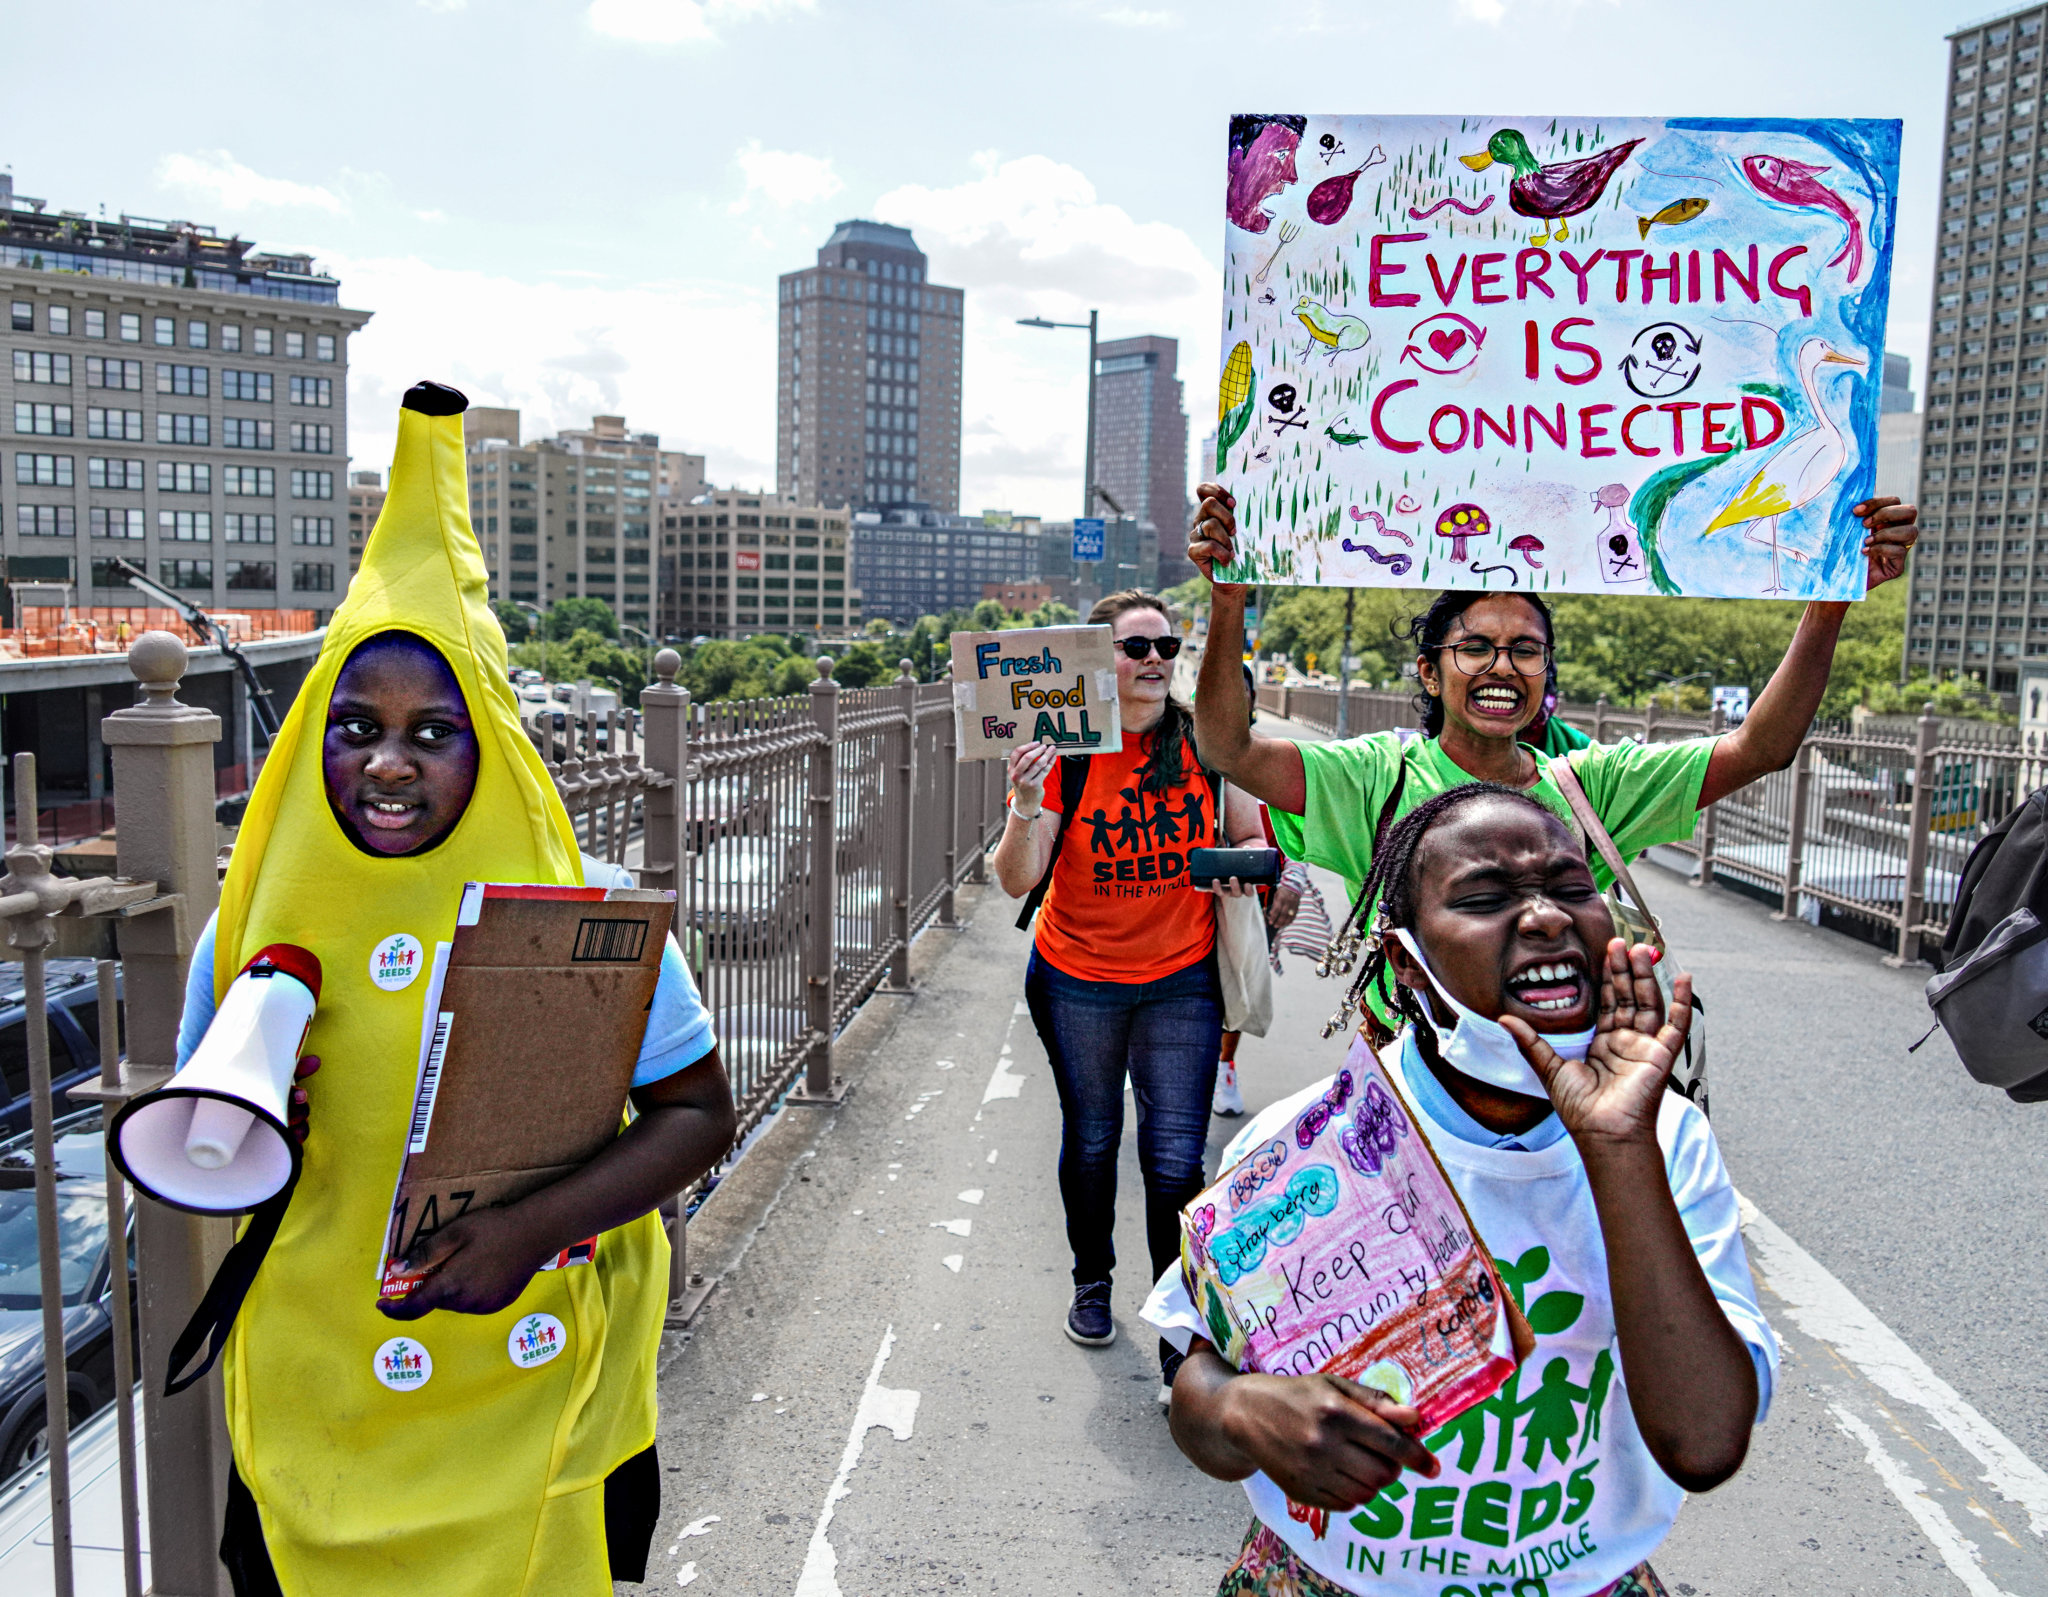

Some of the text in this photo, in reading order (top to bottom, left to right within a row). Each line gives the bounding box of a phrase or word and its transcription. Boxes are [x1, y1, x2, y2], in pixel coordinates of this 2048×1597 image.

[1369, 232, 1812, 317] EVERYTHING
[1525, 317, 1603, 385] IS
[1370, 378, 1786, 458] CONNECTED
[976, 642, 1062, 680] Fresh
[1011, 675, 1086, 710] Food
[982, 710, 1102, 743] For ALL
[1094, 876, 1189, 898] IN THE MIL
[378, 967, 412, 978] SEEDS
[383, 1279, 409, 1293] mile
[1281, 1241, 1370, 1316] Keep
[1273, 1266, 1428, 1376] mmunity
[522, 1342, 557, 1362] SEEDS
[386, 1370, 423, 1380] SEEDS
[1348, 1458, 1600, 1547] SEEDS
[1345, 1542, 1386, 1575] IN
[1400, 1545, 1471, 1577] THE
